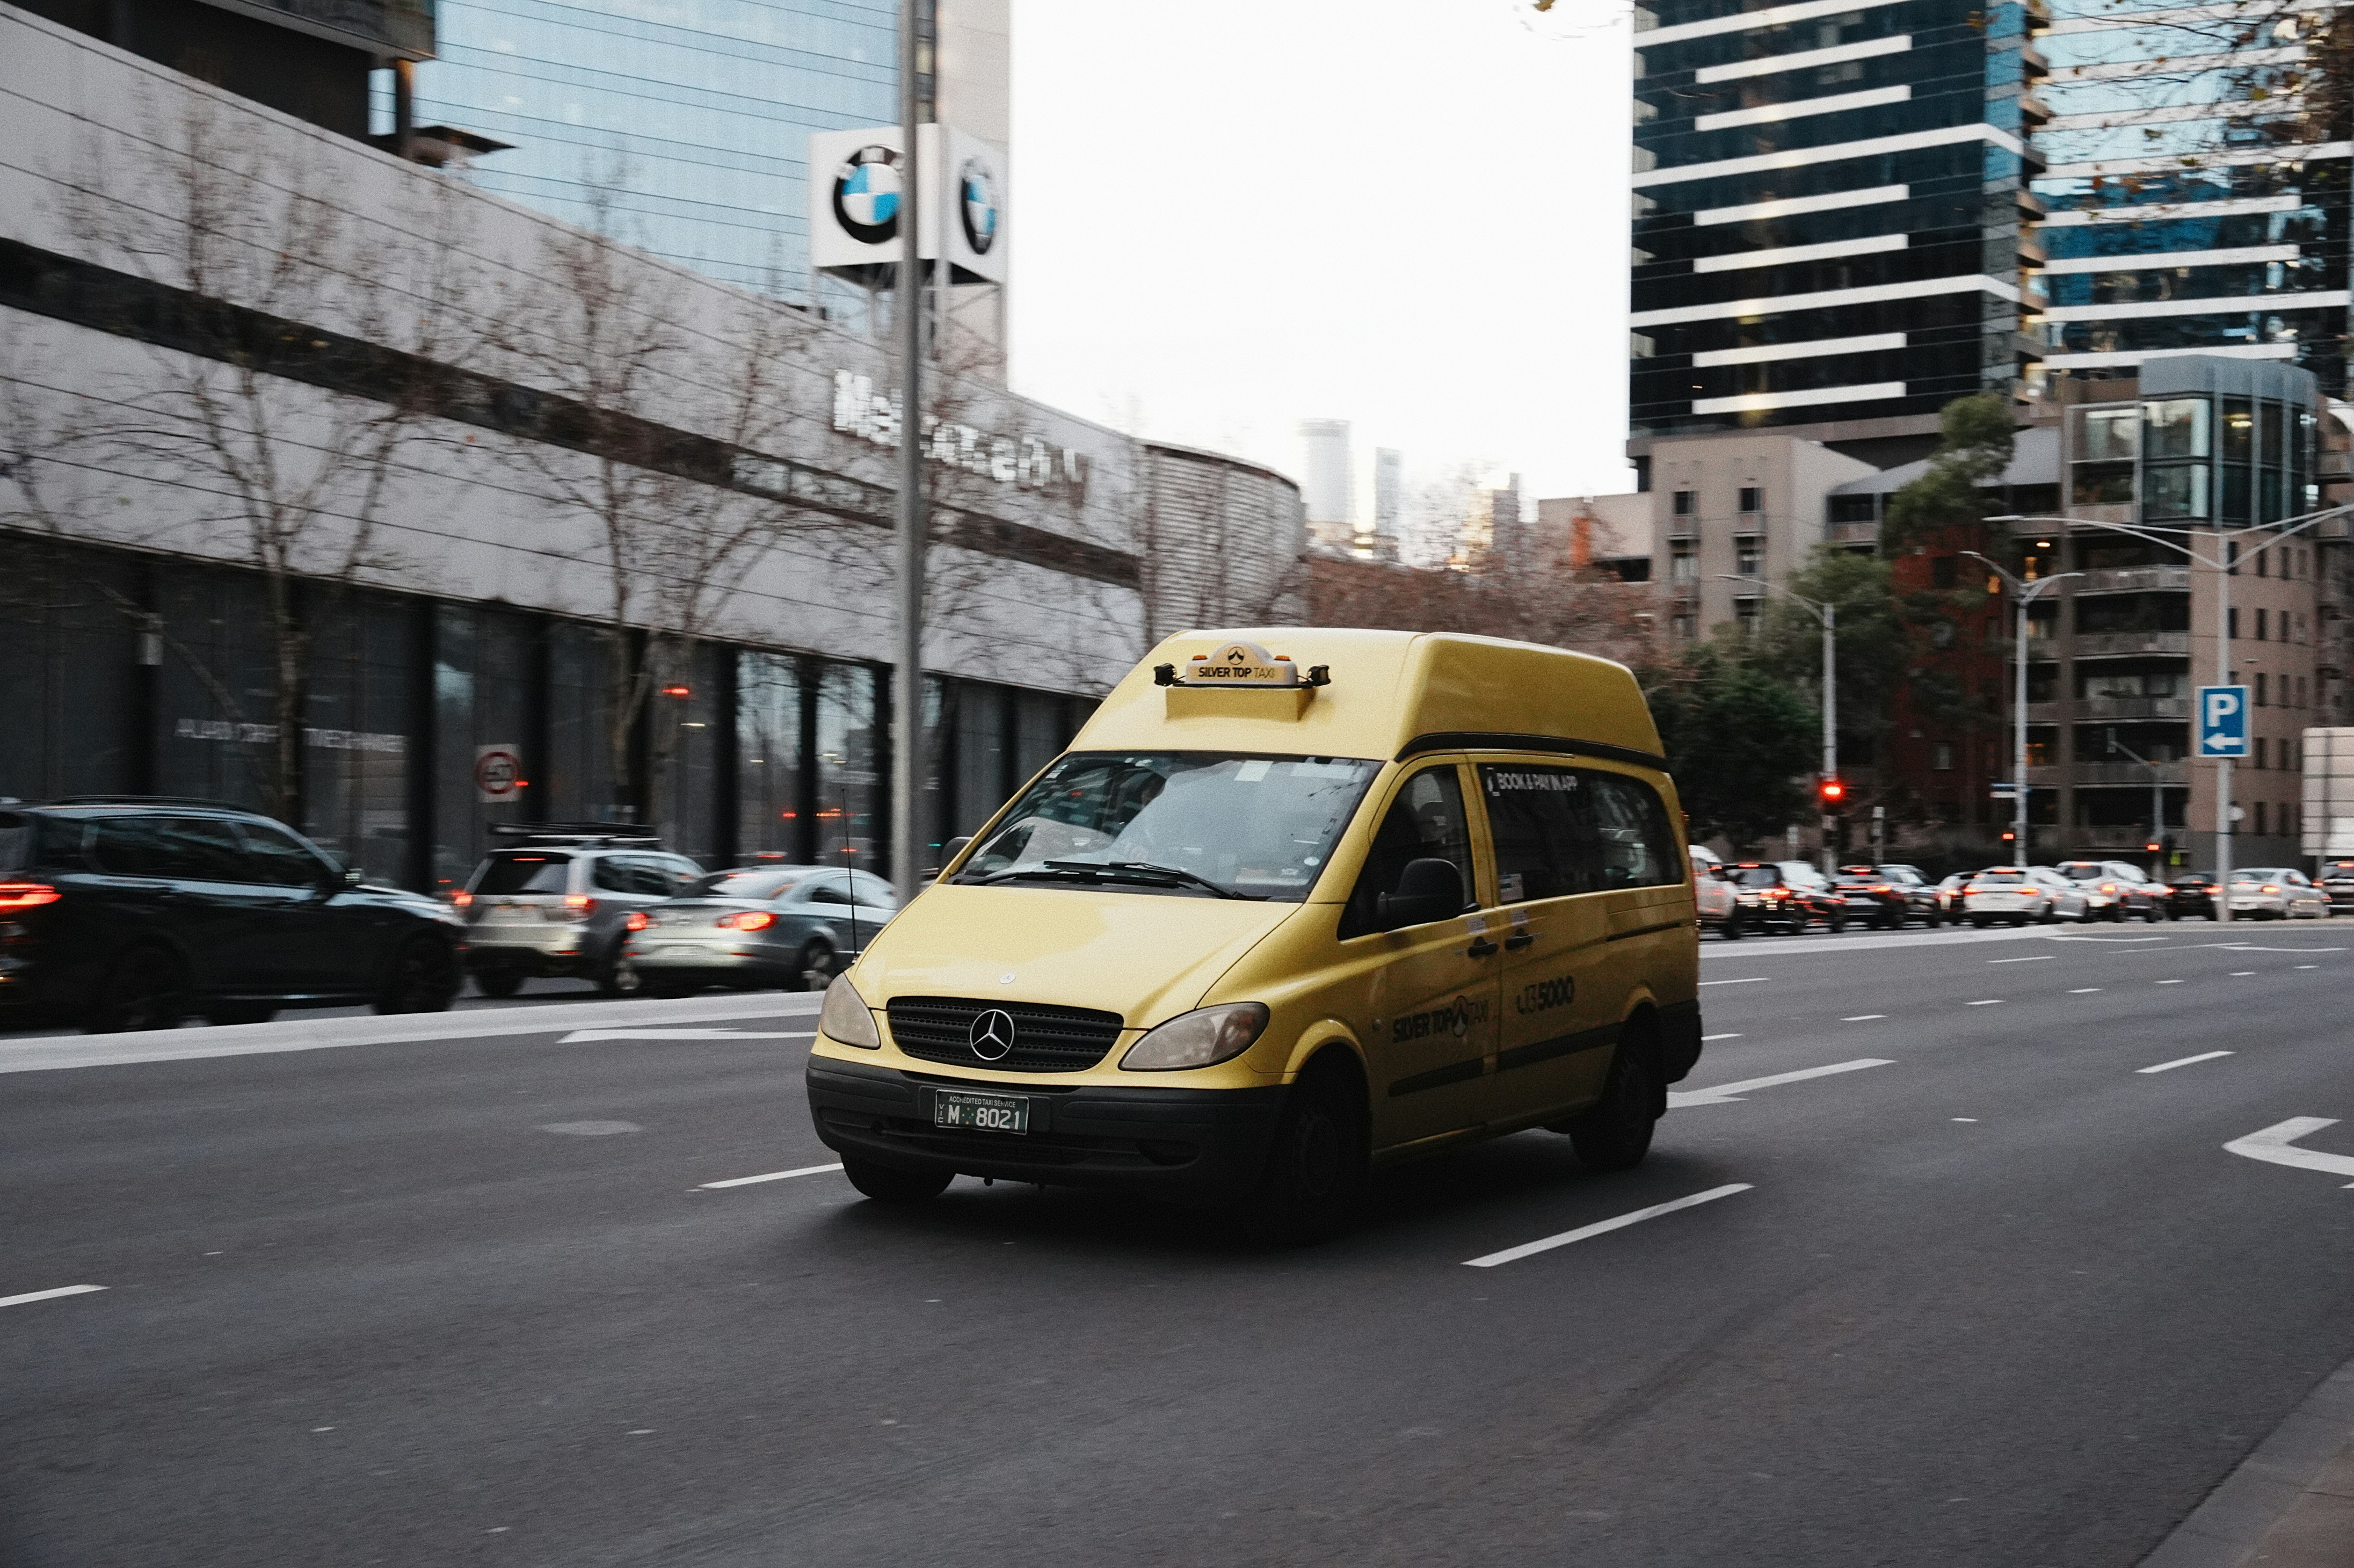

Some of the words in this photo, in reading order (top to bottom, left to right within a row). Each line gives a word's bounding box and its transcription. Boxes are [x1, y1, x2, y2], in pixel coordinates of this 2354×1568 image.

[1199, 667, 1230, 678] SILVER
[1233, 667, 1252, 678] TOP
[1254, 667, 1275, 678] TAXI
[2206, 693, 2239, 727] P
[1393, 1013, 1430, 1043] SILVER
[1432, 1007, 1454, 1034] TOP
[949, 1096, 982, 1105] ACCREDITED
[994, 1100, 1016, 1108] SERVICE
[948, 1105, 960, 1124] M
[976, 1107, 1020, 1130] 8021
